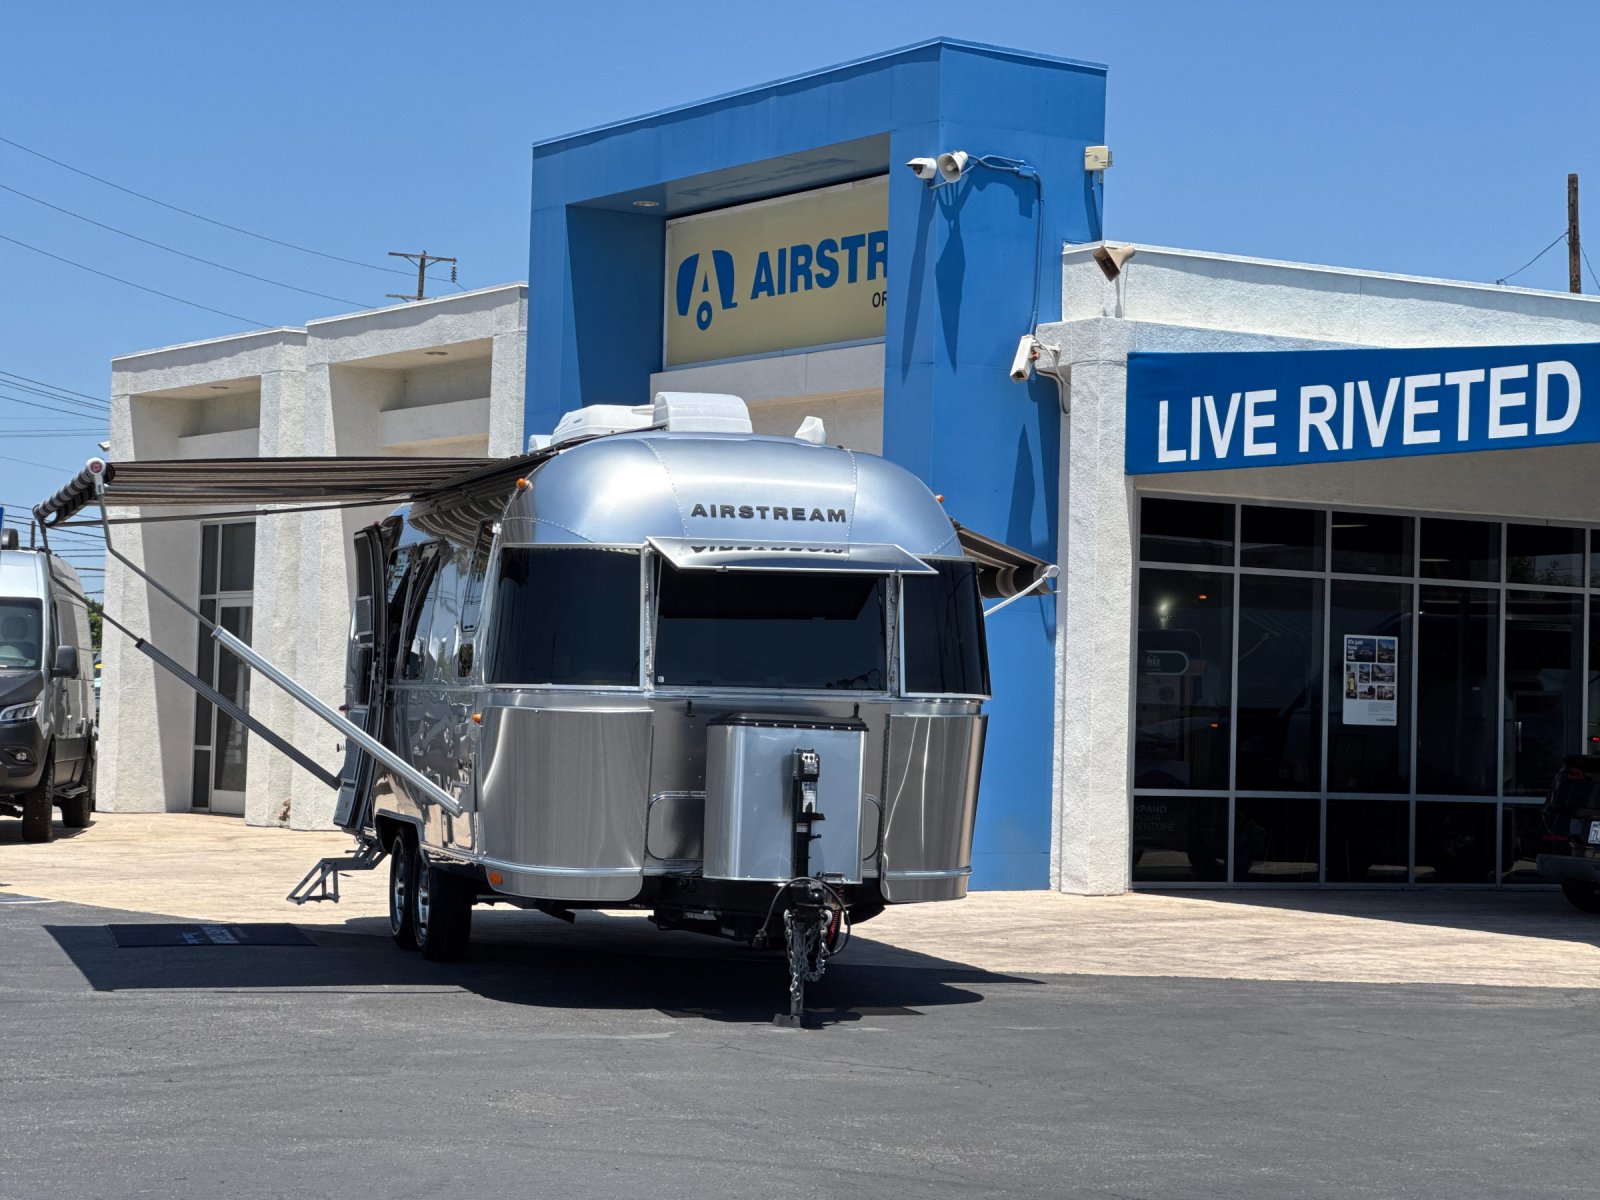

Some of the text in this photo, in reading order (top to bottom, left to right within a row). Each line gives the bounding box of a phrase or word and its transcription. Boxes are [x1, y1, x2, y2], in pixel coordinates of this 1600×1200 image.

[1157, 360, 1581, 463] LIVE RIVETED
[690, 503, 847, 523] AIRSTREAM
